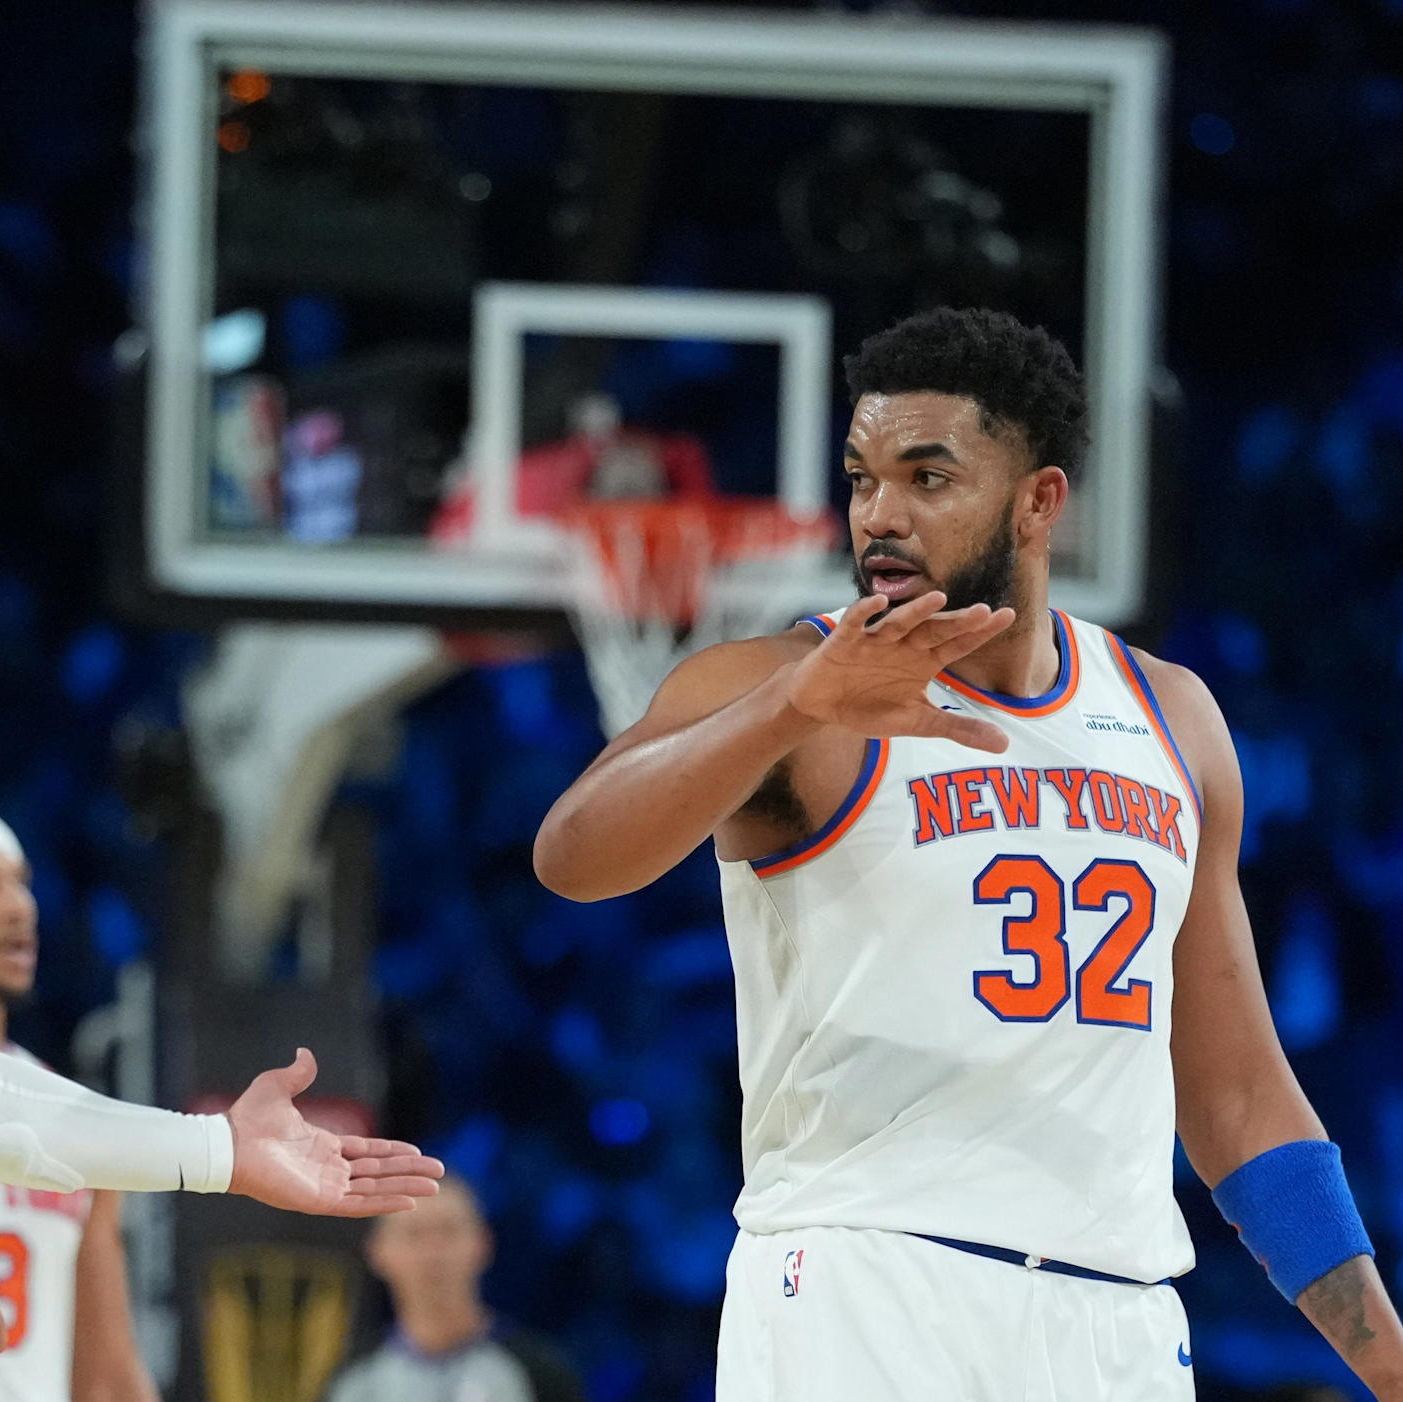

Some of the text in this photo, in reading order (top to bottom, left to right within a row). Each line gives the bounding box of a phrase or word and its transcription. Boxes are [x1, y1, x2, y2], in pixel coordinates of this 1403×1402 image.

[1085, 719, 1151, 736] abu dhabi
[906, 765, 1188, 867] NEW YORK
[973, 854, 1157, 1032] 32
